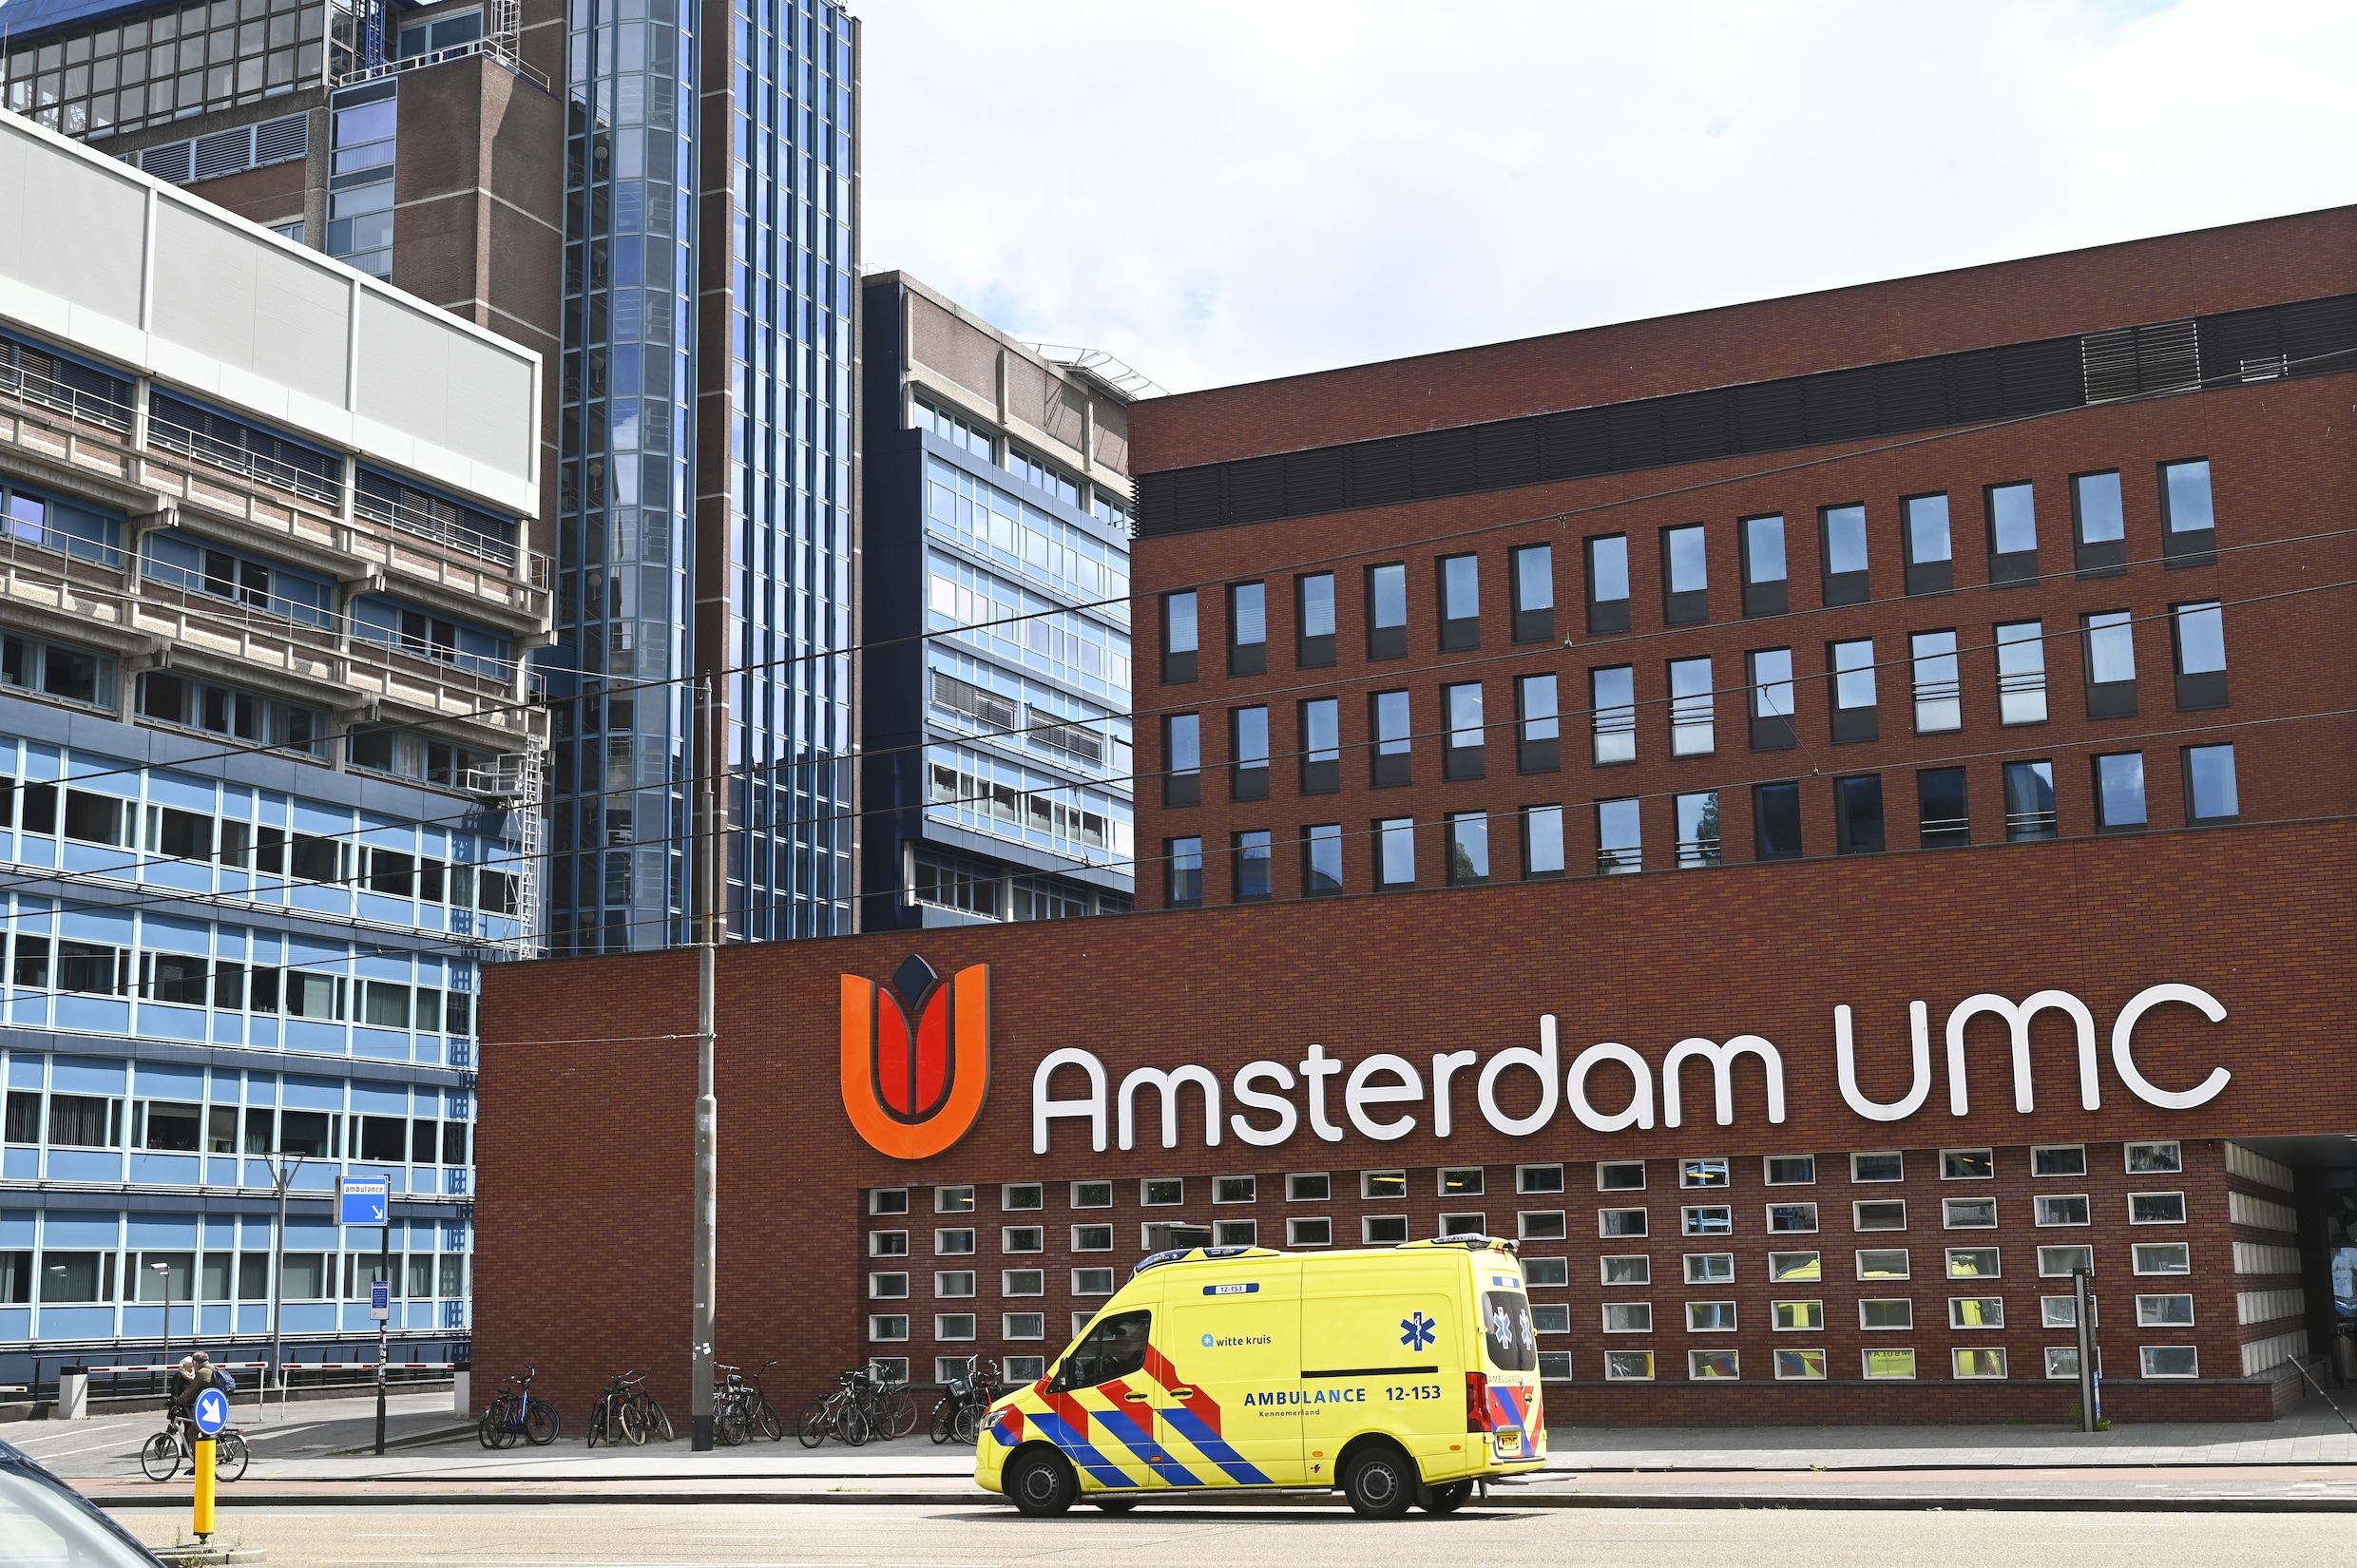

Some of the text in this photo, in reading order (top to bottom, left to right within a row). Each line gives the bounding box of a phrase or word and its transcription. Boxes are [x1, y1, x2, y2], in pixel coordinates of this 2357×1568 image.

[1032, 1013, 1786, 1155] Amsterdam
[345, 1185, 384, 1194] ambulance
[1217, 1334, 1272, 1347] witte kruis
[1244, 1386, 1442, 1406] AMBULANCE 12-153
[1259, 1408, 1320, 1417] Kennemerland
